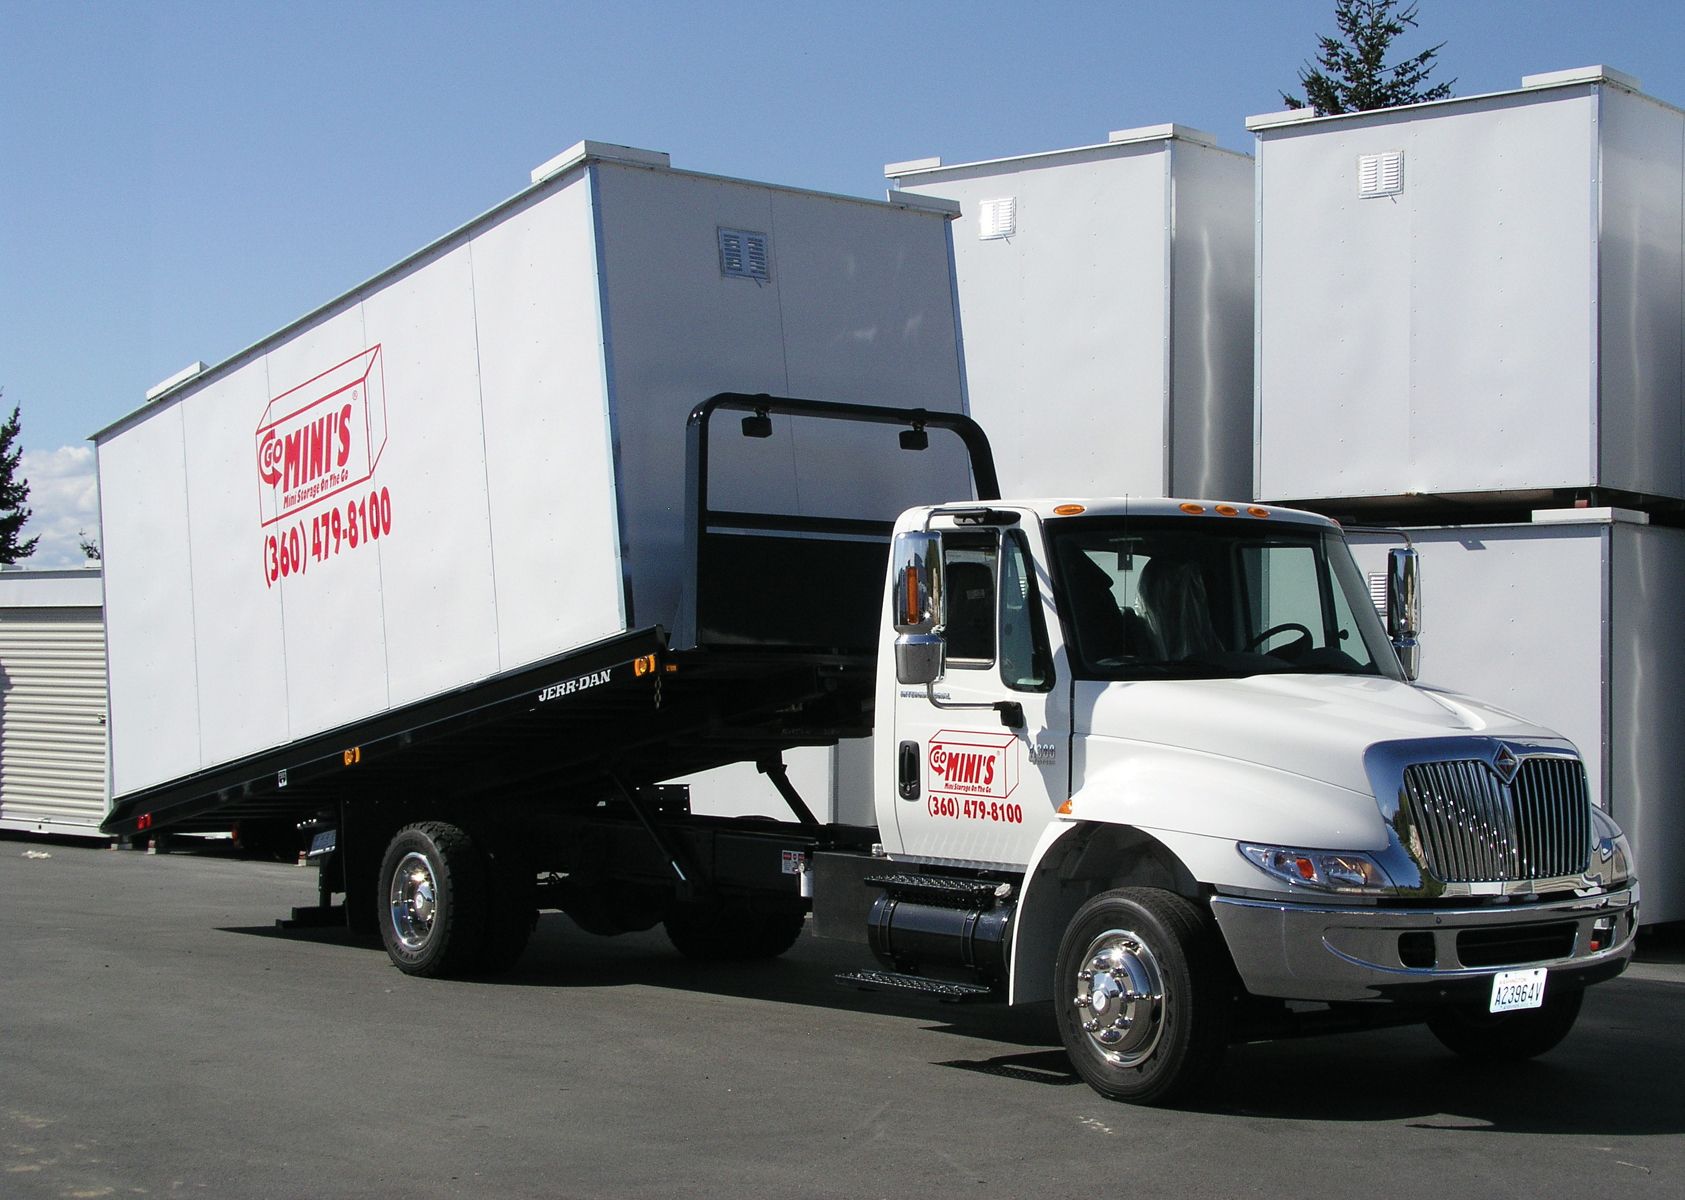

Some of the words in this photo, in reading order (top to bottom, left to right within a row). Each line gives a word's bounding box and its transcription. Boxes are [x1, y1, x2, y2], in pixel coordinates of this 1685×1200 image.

[283, 403, 352, 494] MINI'S
[283, 494, 297, 509] Mini
[297, 489, 320, 504] Storage
[320, 478, 329, 492] On
[329, 473, 340, 488] The
[340, 468, 349, 482] Go
[264, 519, 307, 589] (360)
[312, 486, 391, 562] 479-8100
[944, 752, 996, 785] MINI'S
[928, 795, 960, 819] (360)
[963, 799, 1023, 824] 479-8100
[1495, 982, 1542, 1005] A23964V
